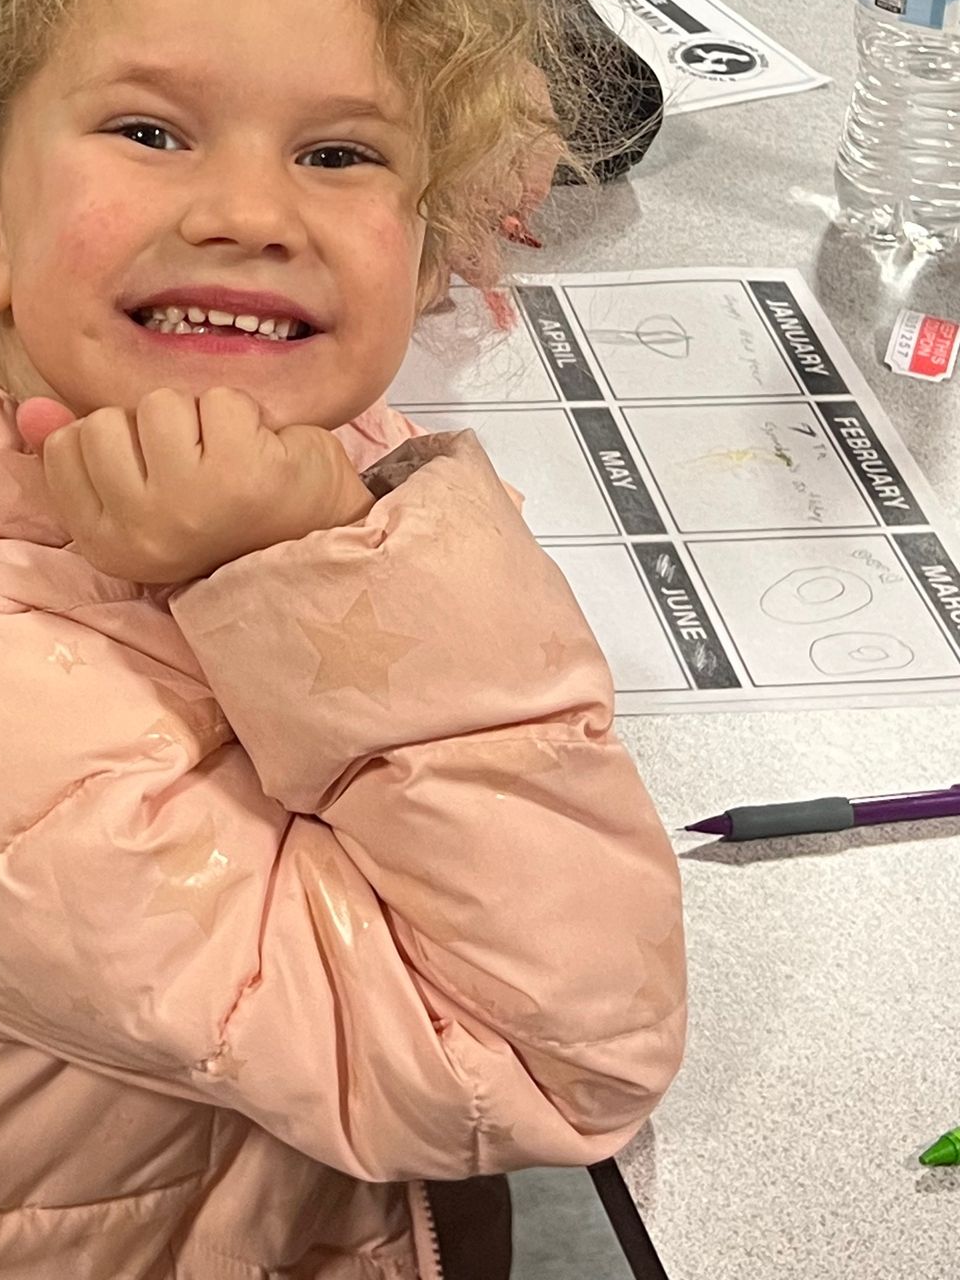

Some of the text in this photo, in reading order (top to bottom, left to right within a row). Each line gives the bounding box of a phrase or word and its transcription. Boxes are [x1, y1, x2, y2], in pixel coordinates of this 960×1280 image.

[538, 318, 577, 369] APRIL
[765, 299, 830, 376] JANUARY
[598, 450, 638, 490] MAY
[833, 416, 910, 510] FEBRUARY
[661, 586, 708, 640] JUNE
[921, 565, 960, 630] MAR
